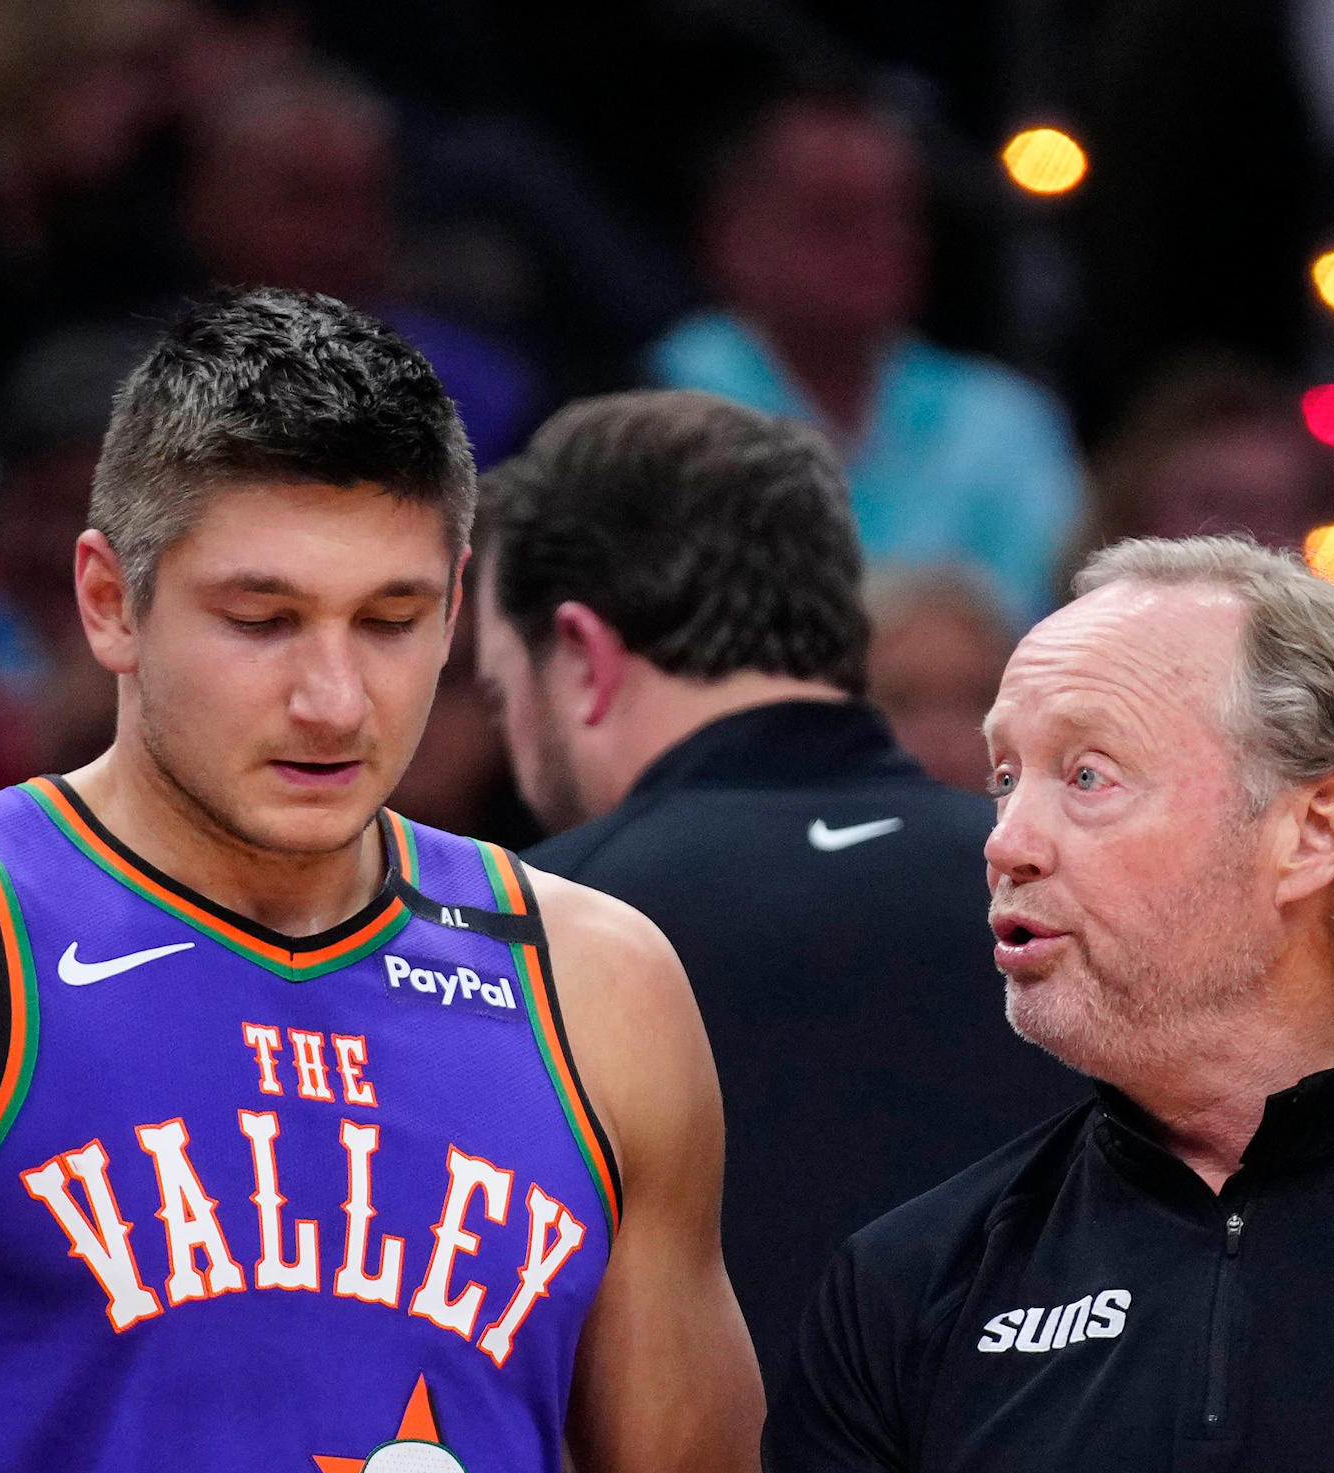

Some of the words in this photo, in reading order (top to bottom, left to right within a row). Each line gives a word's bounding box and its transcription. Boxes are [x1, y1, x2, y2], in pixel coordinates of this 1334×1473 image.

[440, 906, 469, 928] AL
[384, 954, 517, 1009] PayPal
[241, 1021, 378, 1108] THE
[19, 1108, 587, 1370] VALLEY
